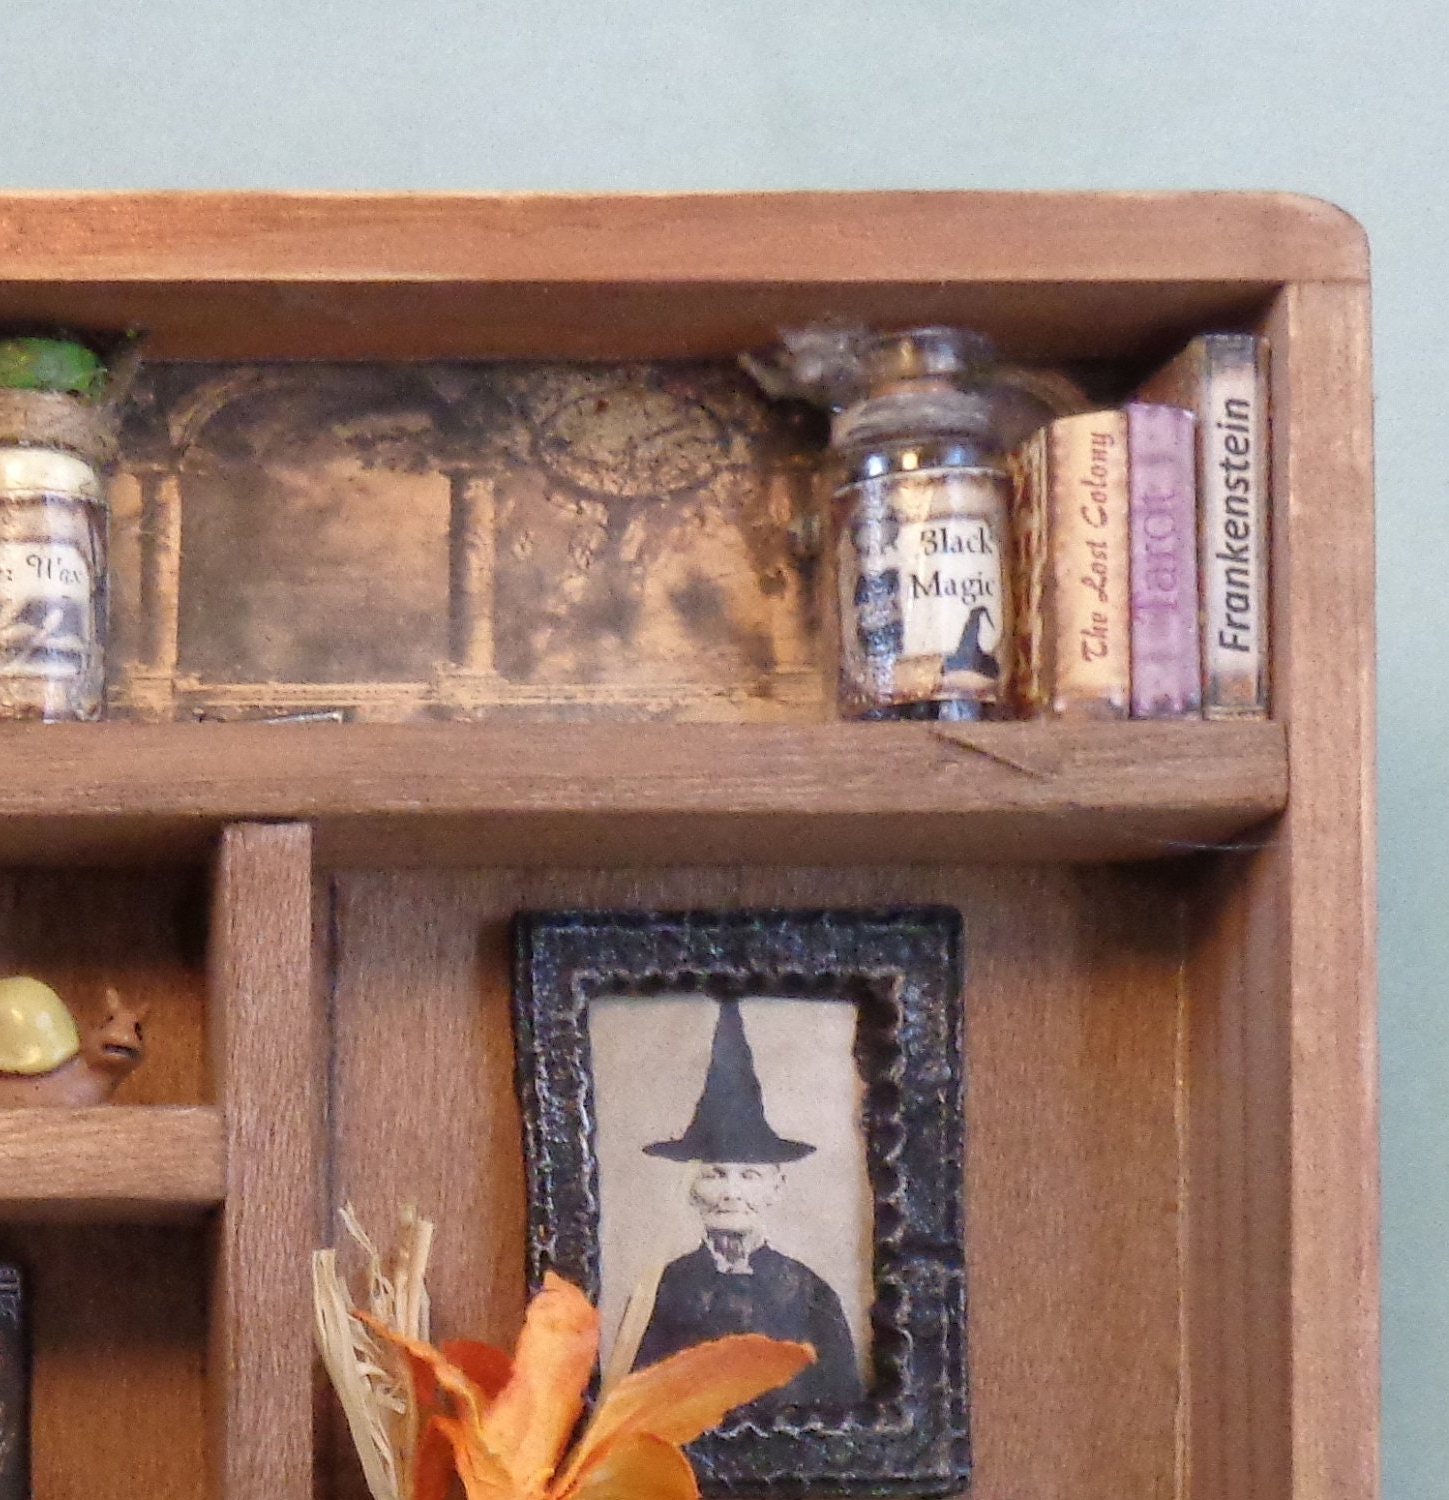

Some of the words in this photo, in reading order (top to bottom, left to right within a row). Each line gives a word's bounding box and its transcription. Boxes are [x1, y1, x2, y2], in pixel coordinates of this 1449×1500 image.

[1081, 432, 1115, 530] Colony
[920, 527, 993, 556] Black
[1216, 397, 1251, 654] Frankenstein
[910, 571, 994, 605] Magic
[1081, 540, 1110, 605] Lost
[1081, 613, 1111, 664] The
